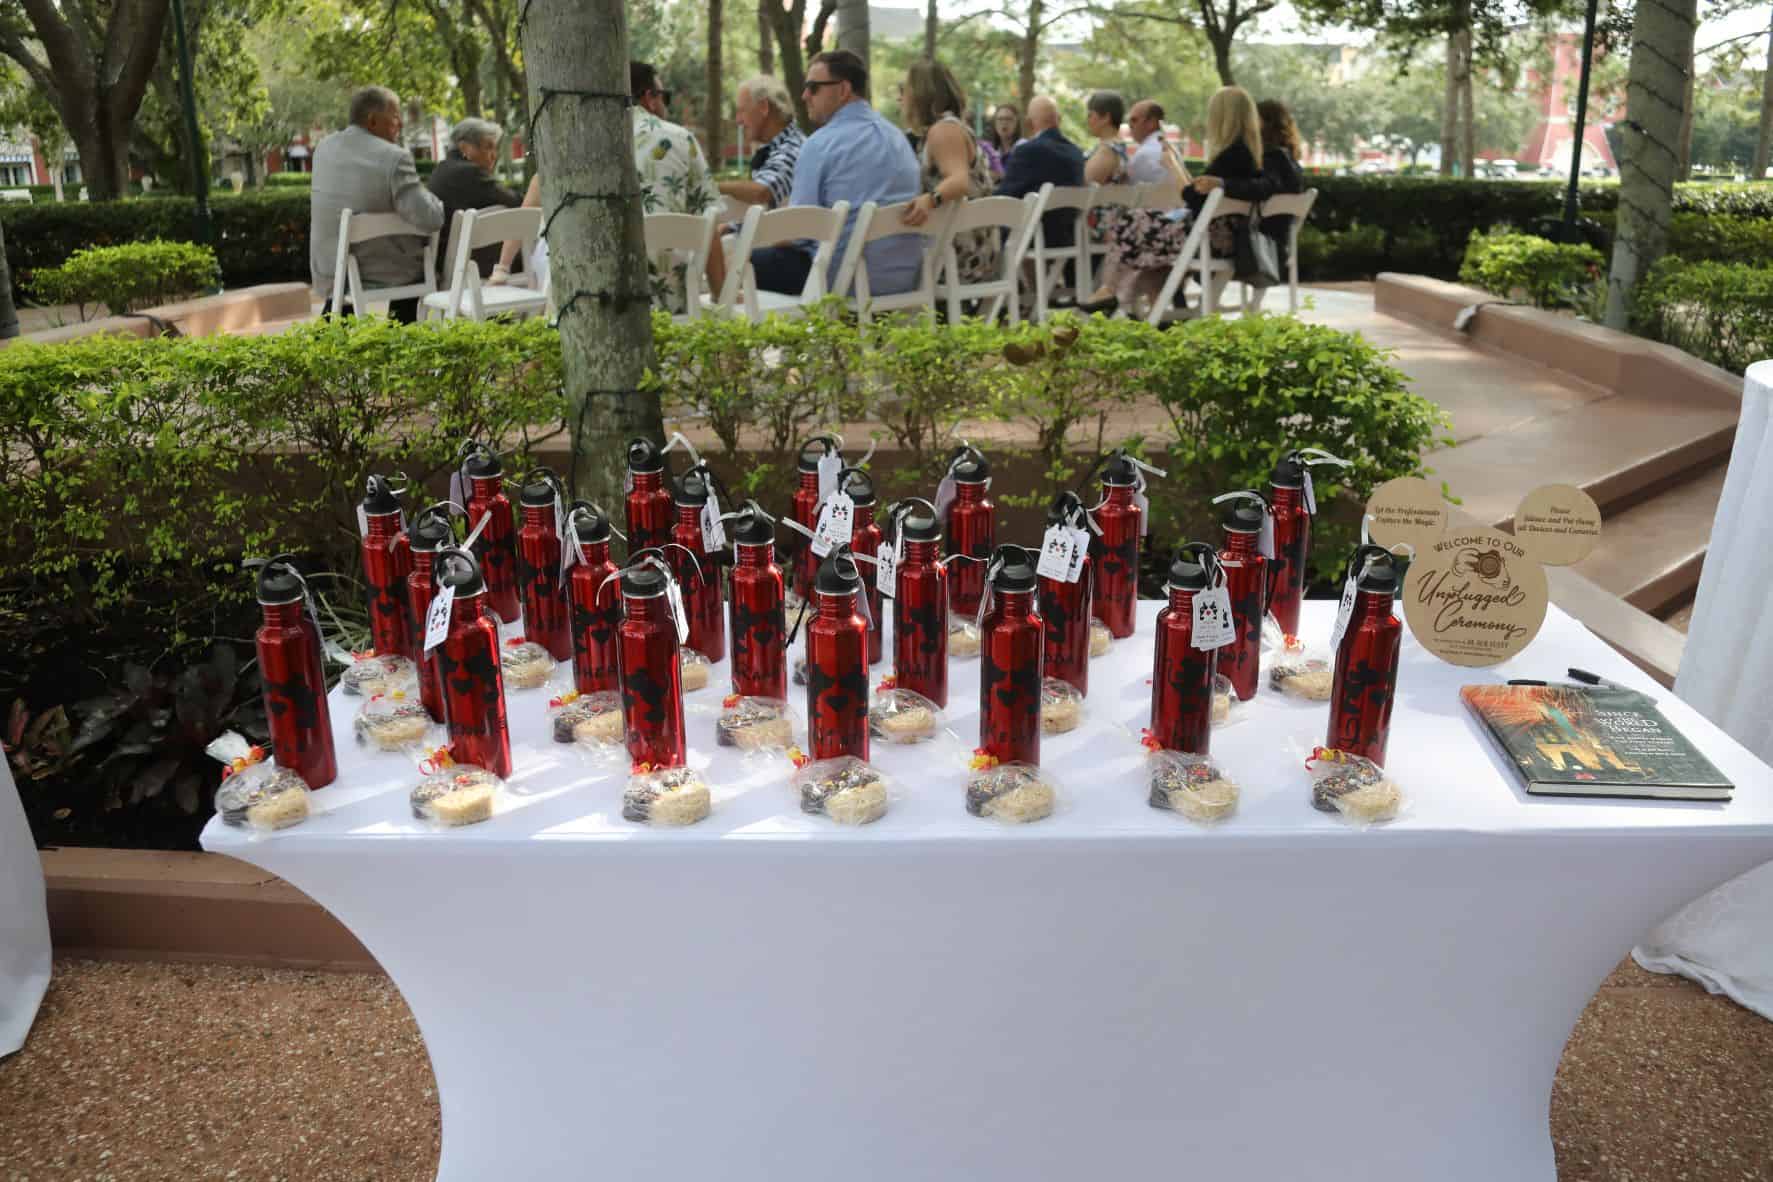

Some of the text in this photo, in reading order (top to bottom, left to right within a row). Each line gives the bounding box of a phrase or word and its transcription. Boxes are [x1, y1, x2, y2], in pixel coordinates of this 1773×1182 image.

[1433, 535, 1525, 559] WELCOME TO OUR
[1416, 569, 1527, 611] Unplugged
[1433, 599, 1528, 641] Ceremony
